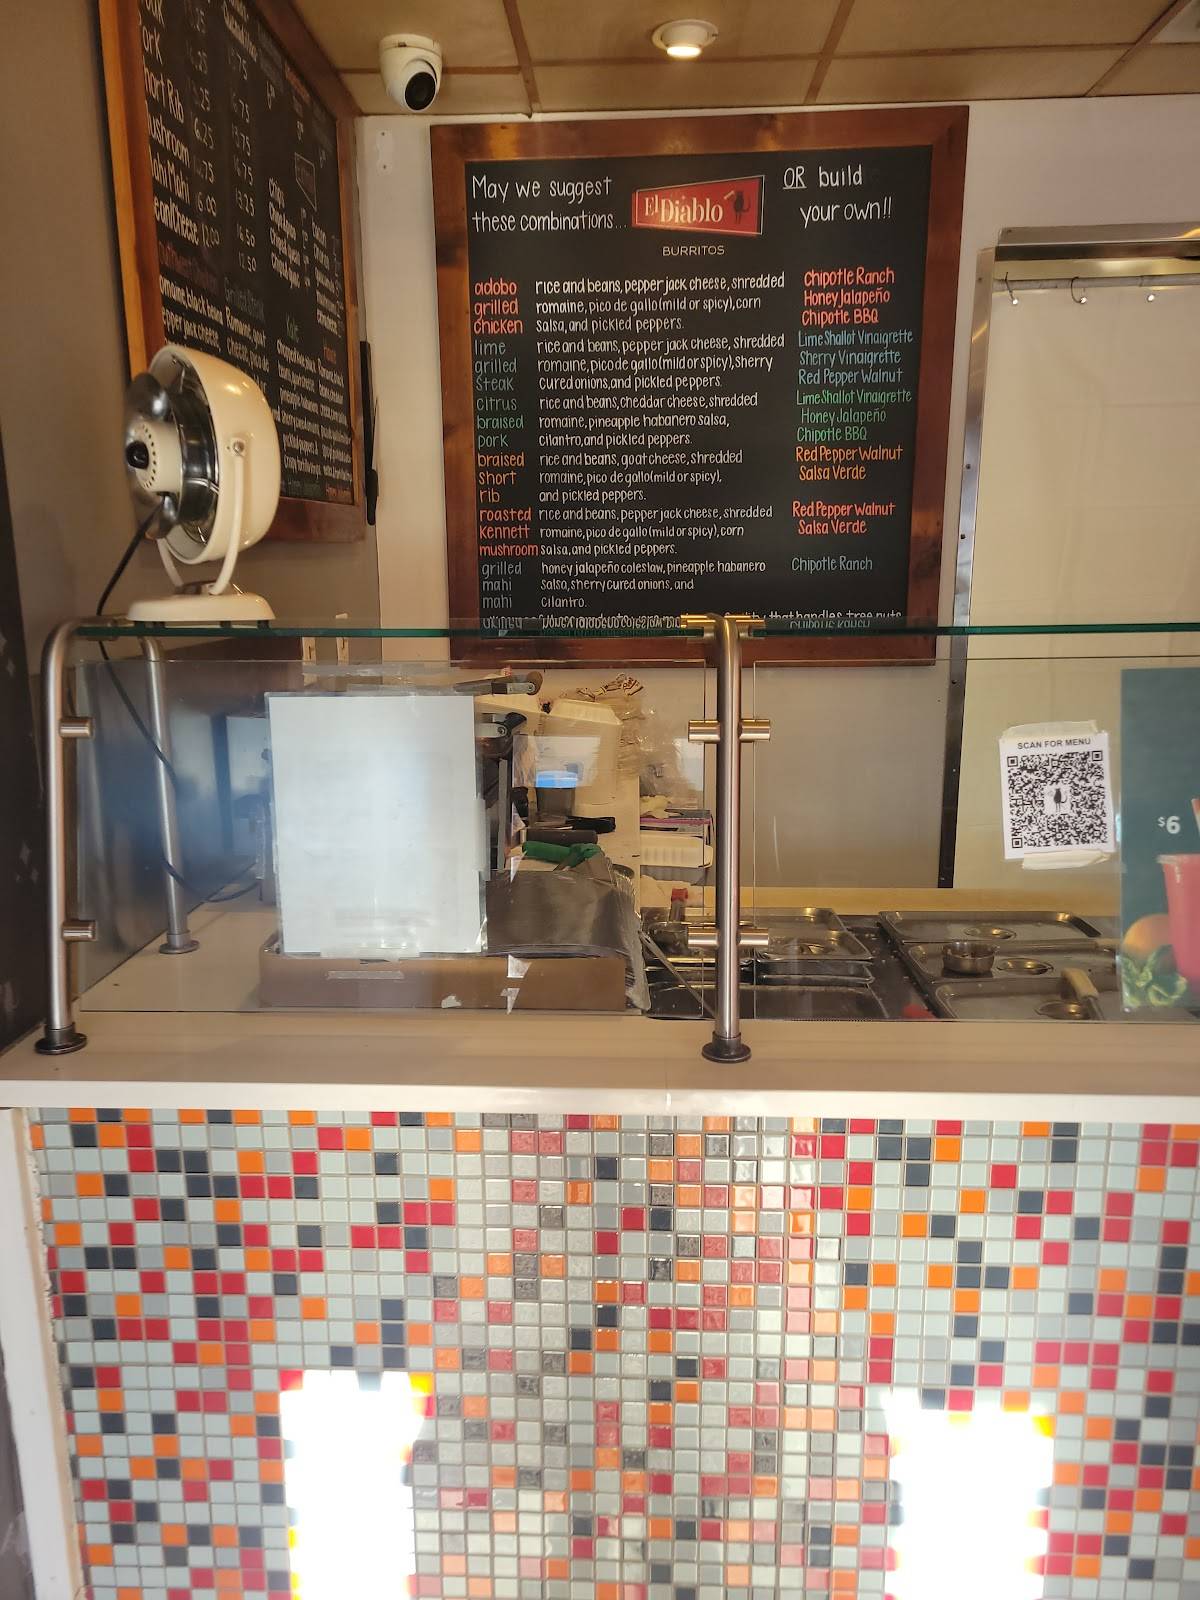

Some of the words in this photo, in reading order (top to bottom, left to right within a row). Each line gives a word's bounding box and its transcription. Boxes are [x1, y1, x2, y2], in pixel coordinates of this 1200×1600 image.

[783, 166, 807, 189] OR
[819, 164, 862, 187] build
[472, 175, 508, 203] May
[515, 180, 541, 198] we
[549, 176, 612, 204] suggest
[644, 195, 658, 216] El
[660, 197, 723, 224] Diablo
[800, 200, 840, 229] your
[844, 197, 892, 221] own!!
[472, 211, 516, 232] these
[663, 246, 725, 256] BURRITOS
[535, 279, 560, 294] rice
[563, 278, 584, 294] and
[587, 279, 622, 293] beans,
[625, 279, 662, 295] pepper
[663, 277, 687, 295] jack
[689, 277, 730, 291] cheese,
[731, 272, 784, 289] shredded
[856, 267, 895, 284] Ranch
[475, 278, 517, 295] adobo
[589, 300, 611, 313] pico
[613, 298, 627, 312] de
[689, 299, 700, 309] or
[804, 290, 838, 307] Honey
[839, 287, 890, 308] Jalapeño
[474, 299, 518, 319] grilled
[592, 317, 631, 334] pickled
[802, 309, 850, 328] Chipotle
[854, 308, 879, 323] BBQ
[474, 340, 506, 355] lime
[537, 342, 560, 353] rice
[562, 339, 584, 352] and
[622, 341, 663, 355] pepper
[664, 338, 688, 355] jack
[691, 337, 731, 350] cheese,
[733, 333, 784, 348] shredded
[799, 330, 823, 347] Lime
[825, 330, 856, 345] Shallot
[858, 329, 913, 349] Vinaigrette
[800, 351, 836, 368] Sherry
[838, 349, 901, 368] Vinaigrette
[475, 358, 517, 378] grilled
[635, 376, 672, 391] pickled
[799, 368, 820, 384] Red
[823, 368, 860, 387] Pepper
[861, 368, 904, 383] Walnut
[540, 398, 561, 409] rice
[563, 396, 584, 409] and
[857, 388, 912, 408] Vinaigrette
[477, 415, 523, 429] braised
[643, 414, 696, 427] habanero
[802, 408, 835, 426] Honey
[837, 408, 886, 425] Jalapeño
[478, 434, 508, 450] pork
[606, 433, 644, 448] pickled
[797, 427, 842, 444] Chipotle
[845, 426, 867, 440] BBQ
[478, 452, 524, 467] braised
[540, 454, 560, 465] rice
[562, 454, 582, 465] and
[622, 453, 648, 470] goat
[796, 446, 817, 461] Red
[820, 446, 858, 463] Pepper
[859, 444, 903, 460] Walnut
[799, 465, 829, 480] Salsa
[832, 465, 866, 480] Verde
[480, 488, 500, 502] rib
[539, 489, 558, 501] and
[562, 489, 599, 503] pickled
[602, 489, 646, 503] peppers.
[480, 508, 532, 522] roasted
[539, 509, 561, 521] rice
[562, 508, 583, 520] and
[621, 508, 659, 522] pepper
[659, 508, 682, 523] jack
[684, 507, 721, 519] cheese,
[724, 506, 772, 518] shredded
[793, 501, 814, 517] Red
[816, 501, 853, 519] Pepper
[799, 520, 828, 534] Salsa
[831, 519, 867, 534] Verde
[480, 544, 538, 556] mushroom
[594, 543, 631, 556] pickled
[482, 562, 522, 578] grilled
[542, 562, 572, 576] honey
[574, 561, 619, 576] jalapeño
[718, 561, 765, 572] habanero
[792, 556, 837, 573] Chipotle
[840, 556, 872, 570] Ranch
[482, 578, 512, 591] mahi
[675, 579, 694, 589] and
[482, 595, 512, 608] mahi
[1044, 740, 1063, 748] FOR
[1065, 738, 1091, 746] MENU
[1158, 815, 1181, 834] $6
